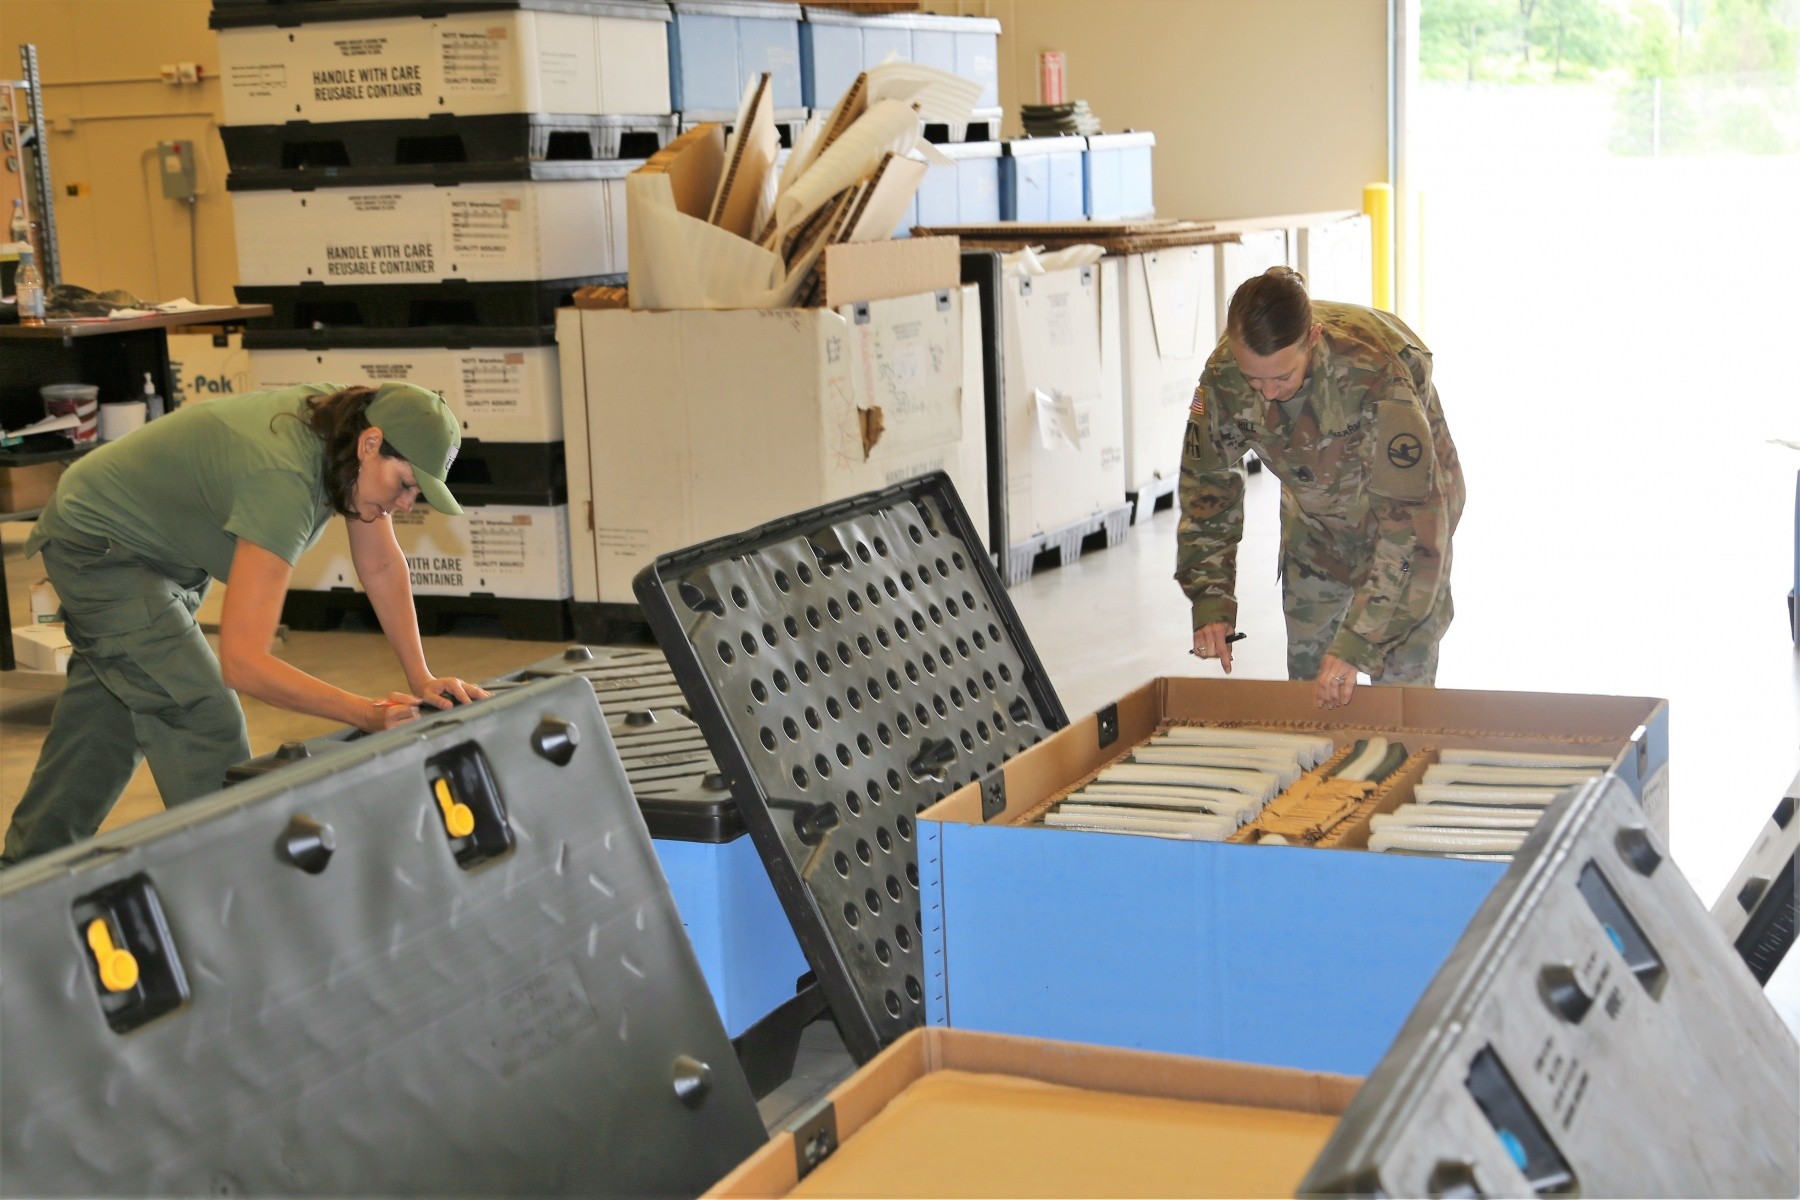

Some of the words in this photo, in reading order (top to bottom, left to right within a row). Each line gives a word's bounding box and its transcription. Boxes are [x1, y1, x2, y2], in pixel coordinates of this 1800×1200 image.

[313, 69, 356, 85] HANDLE
[359, 67, 388, 82] WITH
[391, 65, 421, 80] CARE
[314, 85, 364, 101] REUSABLE
[367, 82, 422, 98] CONTAINER
[326, 245, 369, 260] HANDLE
[371, 244, 400, 259] WITH
[403, 243, 433, 258] CARE
[328, 261, 377, 276] REUSABLE
[379, 260, 435, 274] CONTAINER
[433, 557, 462, 571] CARE
[410, 572, 464, 586] CONTAINER
